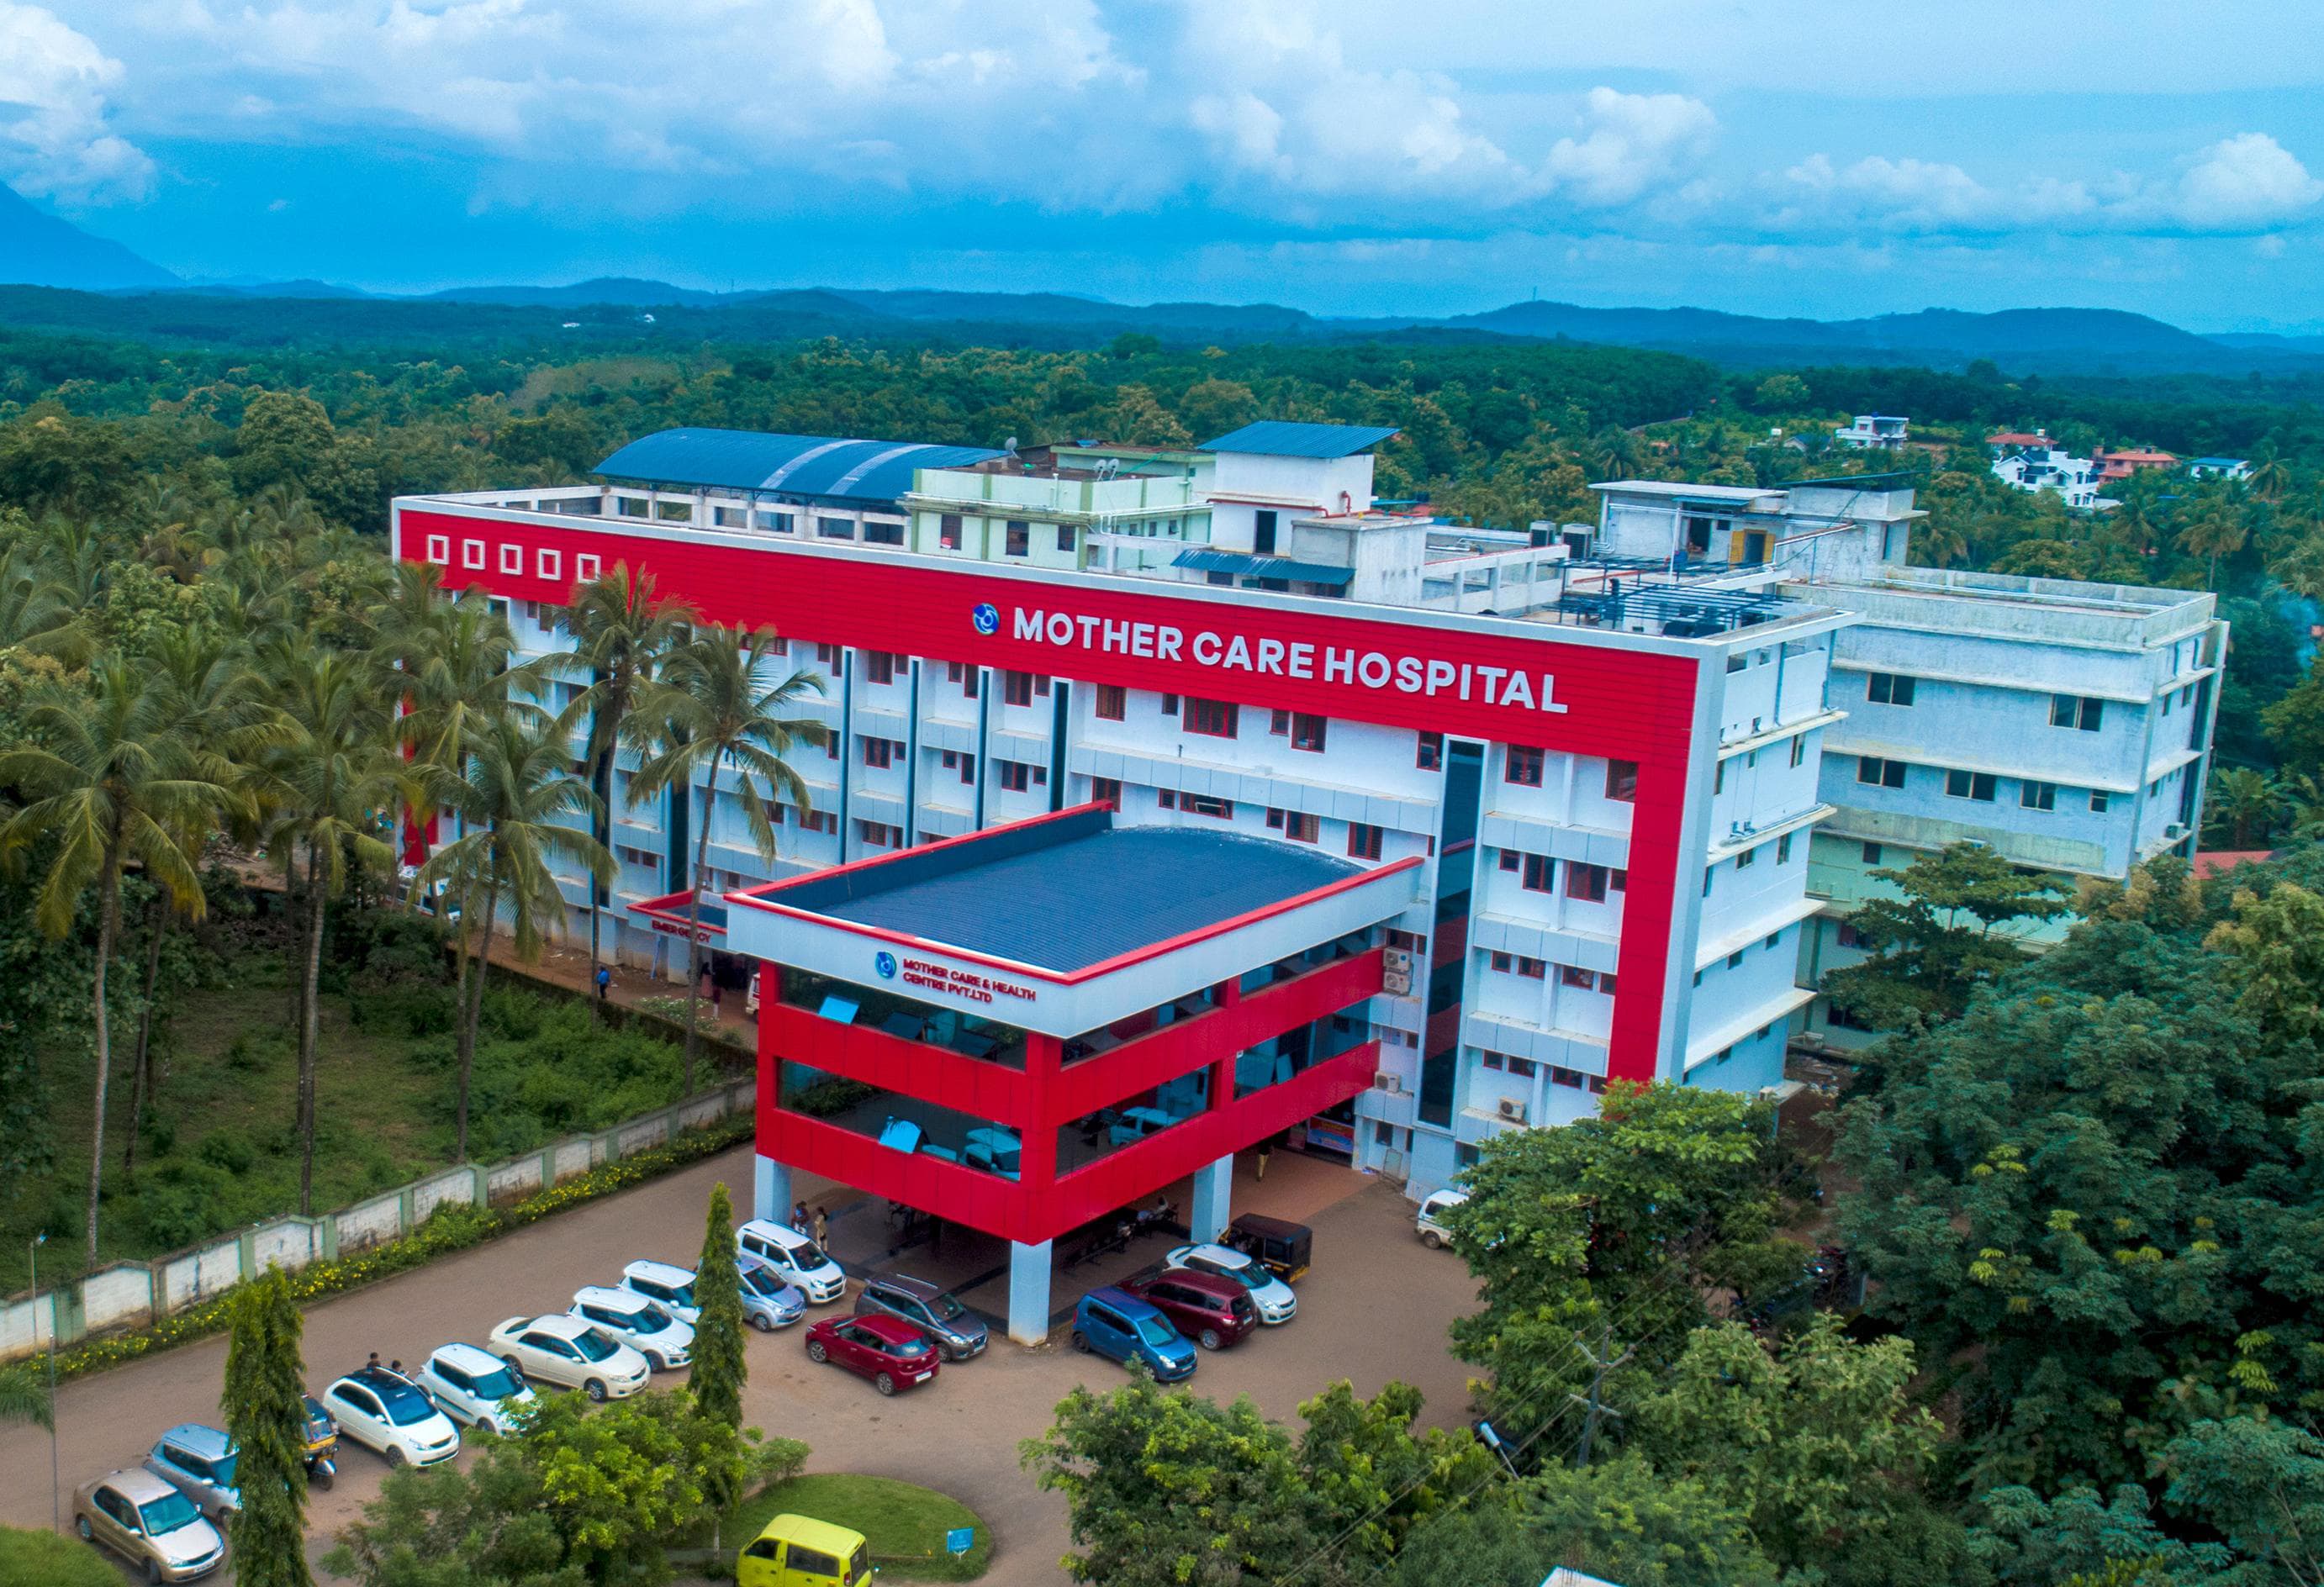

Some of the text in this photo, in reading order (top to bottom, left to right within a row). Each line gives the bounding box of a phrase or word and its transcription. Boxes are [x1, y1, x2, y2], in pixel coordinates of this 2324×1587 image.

[1013, 606, 1569, 714] MOTHER CARE HOSPITAL
[652, 920, 712, 943] EMERGECY
[903, 958, 1037, 1002] MOTHER CARE & HEALTH
[903, 972, 947, 991] CENTRE
